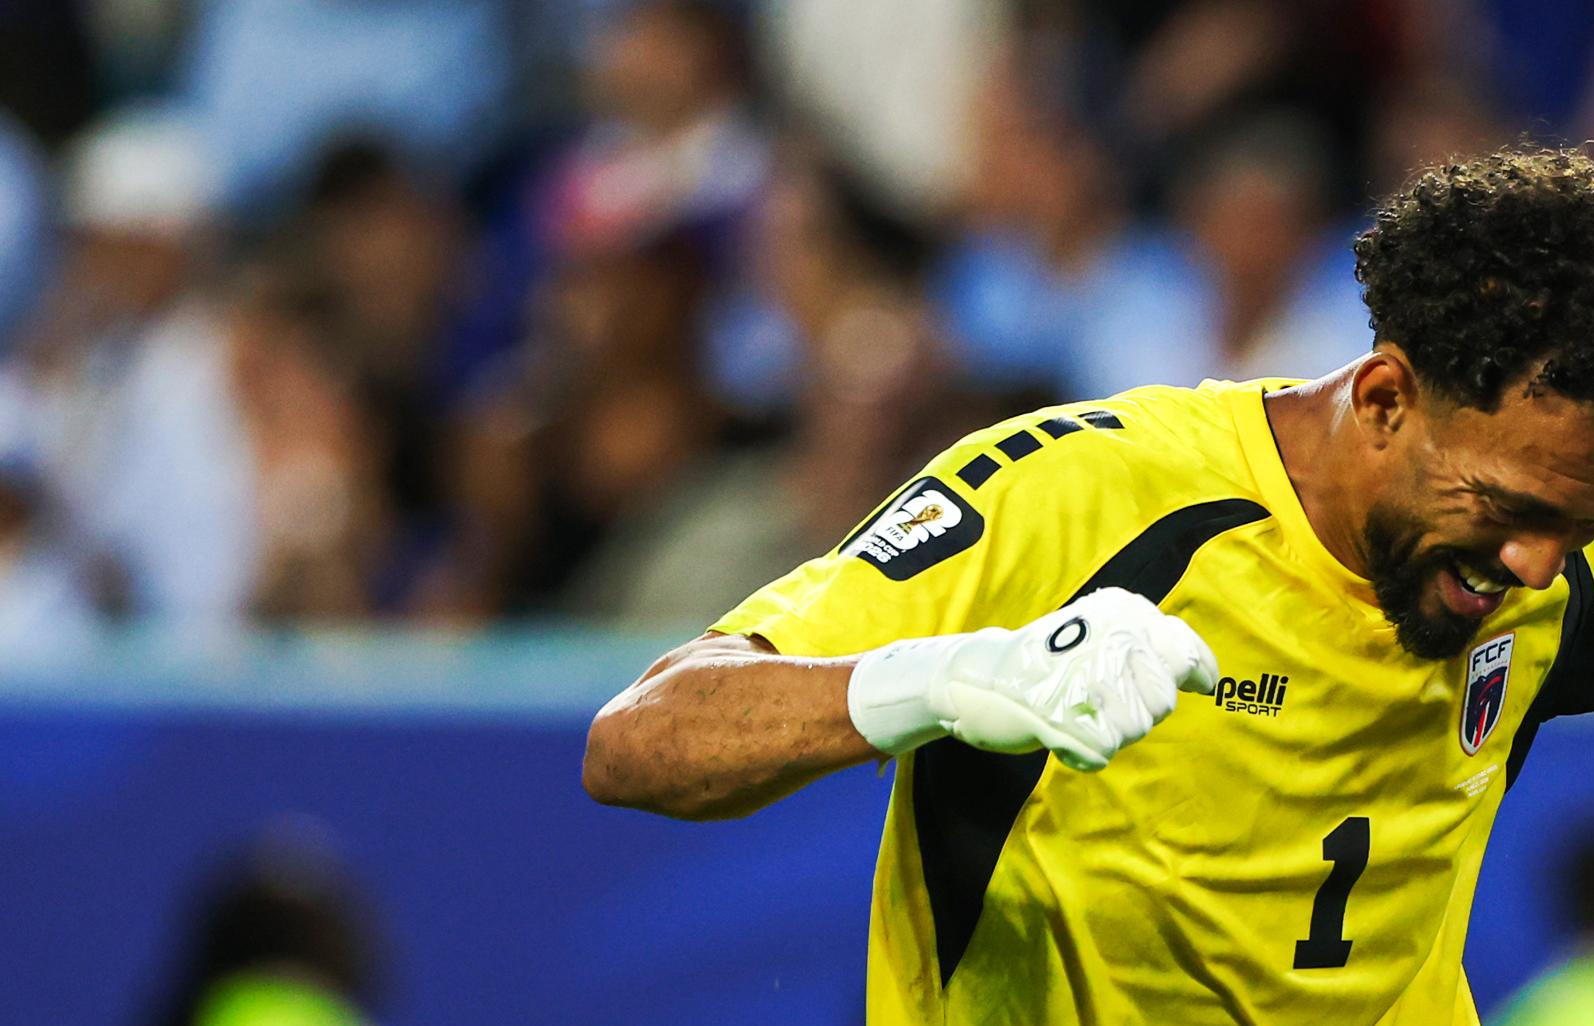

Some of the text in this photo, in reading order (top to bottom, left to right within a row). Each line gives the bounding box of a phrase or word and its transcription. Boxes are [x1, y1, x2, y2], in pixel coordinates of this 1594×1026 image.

[885, 526, 904, 541] FIFA
[884, 545, 900, 557] CUP
[1472, 639, 1511, 672] FCF
[1204, 673, 1289, 707] pelli
[1225, 700, 1281, 717] SPORT
[1293, 817, 1370, 969] 1
